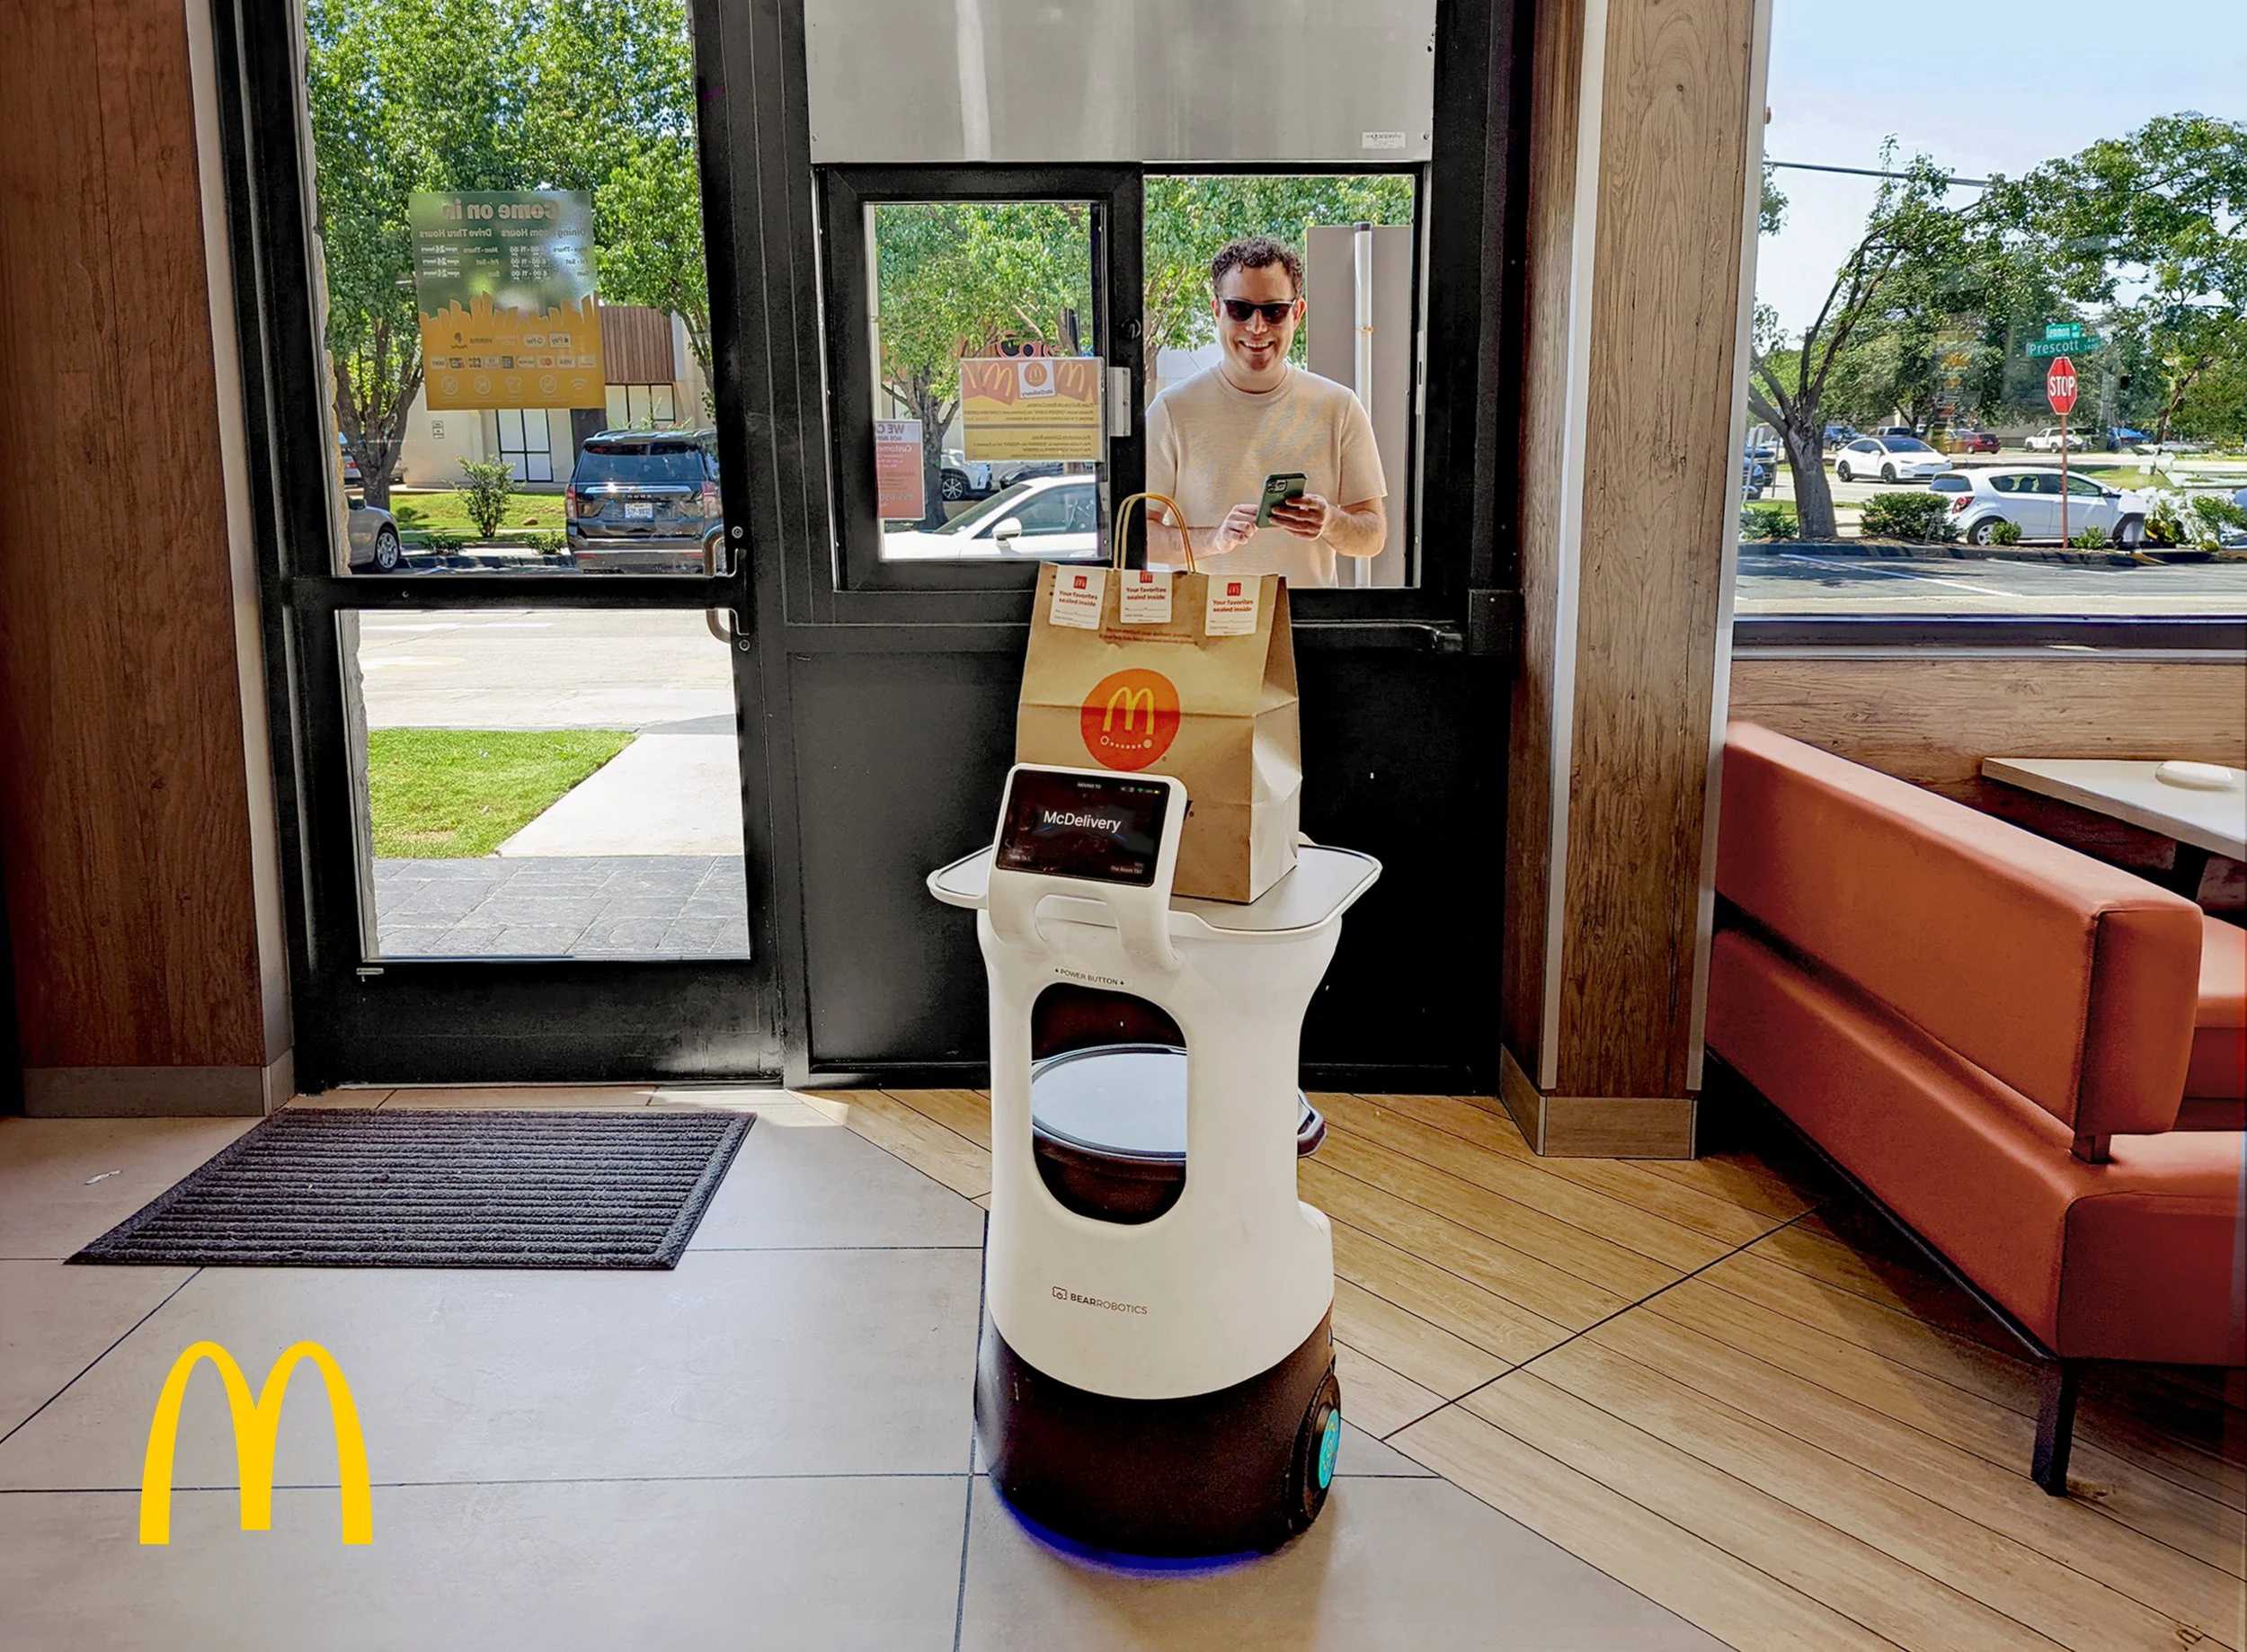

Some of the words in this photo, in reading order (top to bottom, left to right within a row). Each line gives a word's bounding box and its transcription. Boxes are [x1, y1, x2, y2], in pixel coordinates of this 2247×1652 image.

[2029, 340, 2079, 355] Prescott
[2049, 376, 2075, 396] STOP
[1072, 591, 1098, 600] favorites
[1043, 811, 1122, 834] McDelivery
[1061, 968, 1086, 980] POWER
[1088, 974, 1118, 985] BUTTON
